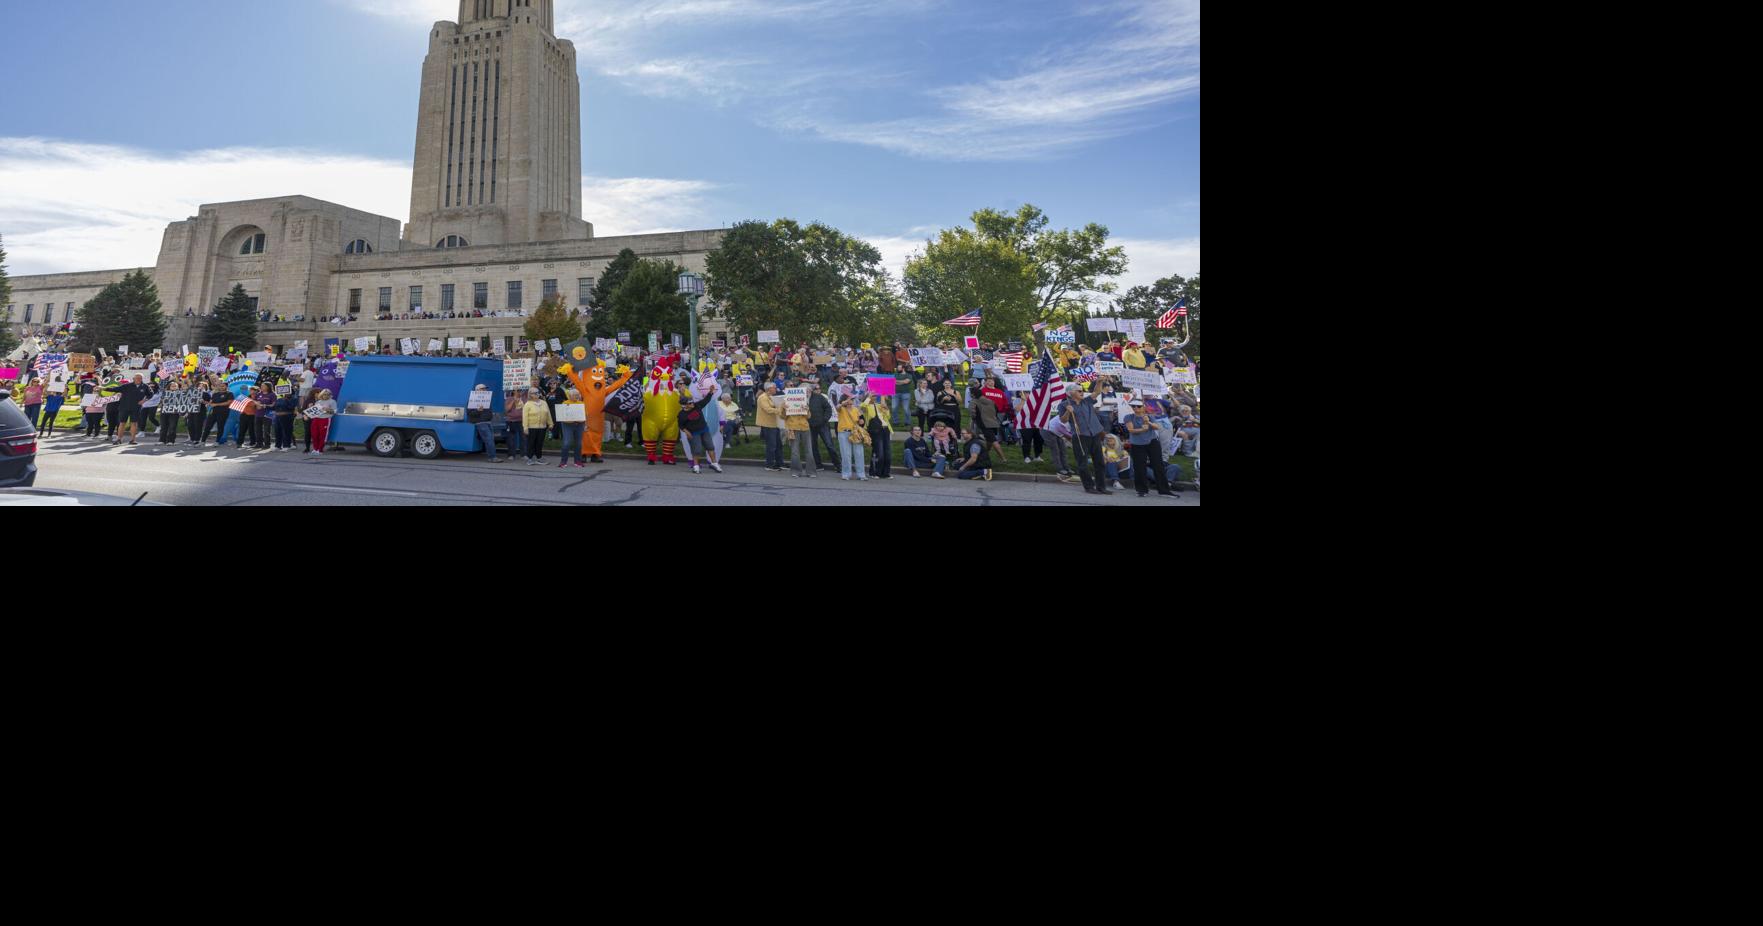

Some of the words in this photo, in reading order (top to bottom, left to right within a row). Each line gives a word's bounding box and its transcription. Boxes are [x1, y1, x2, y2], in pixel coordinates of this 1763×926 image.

[1073, 366, 1093, 374] NO
[164, 388, 203, 398] IMPEACH
[162, 397, 203, 405] CONVICT
[161, 404, 200, 413] REMOVE
